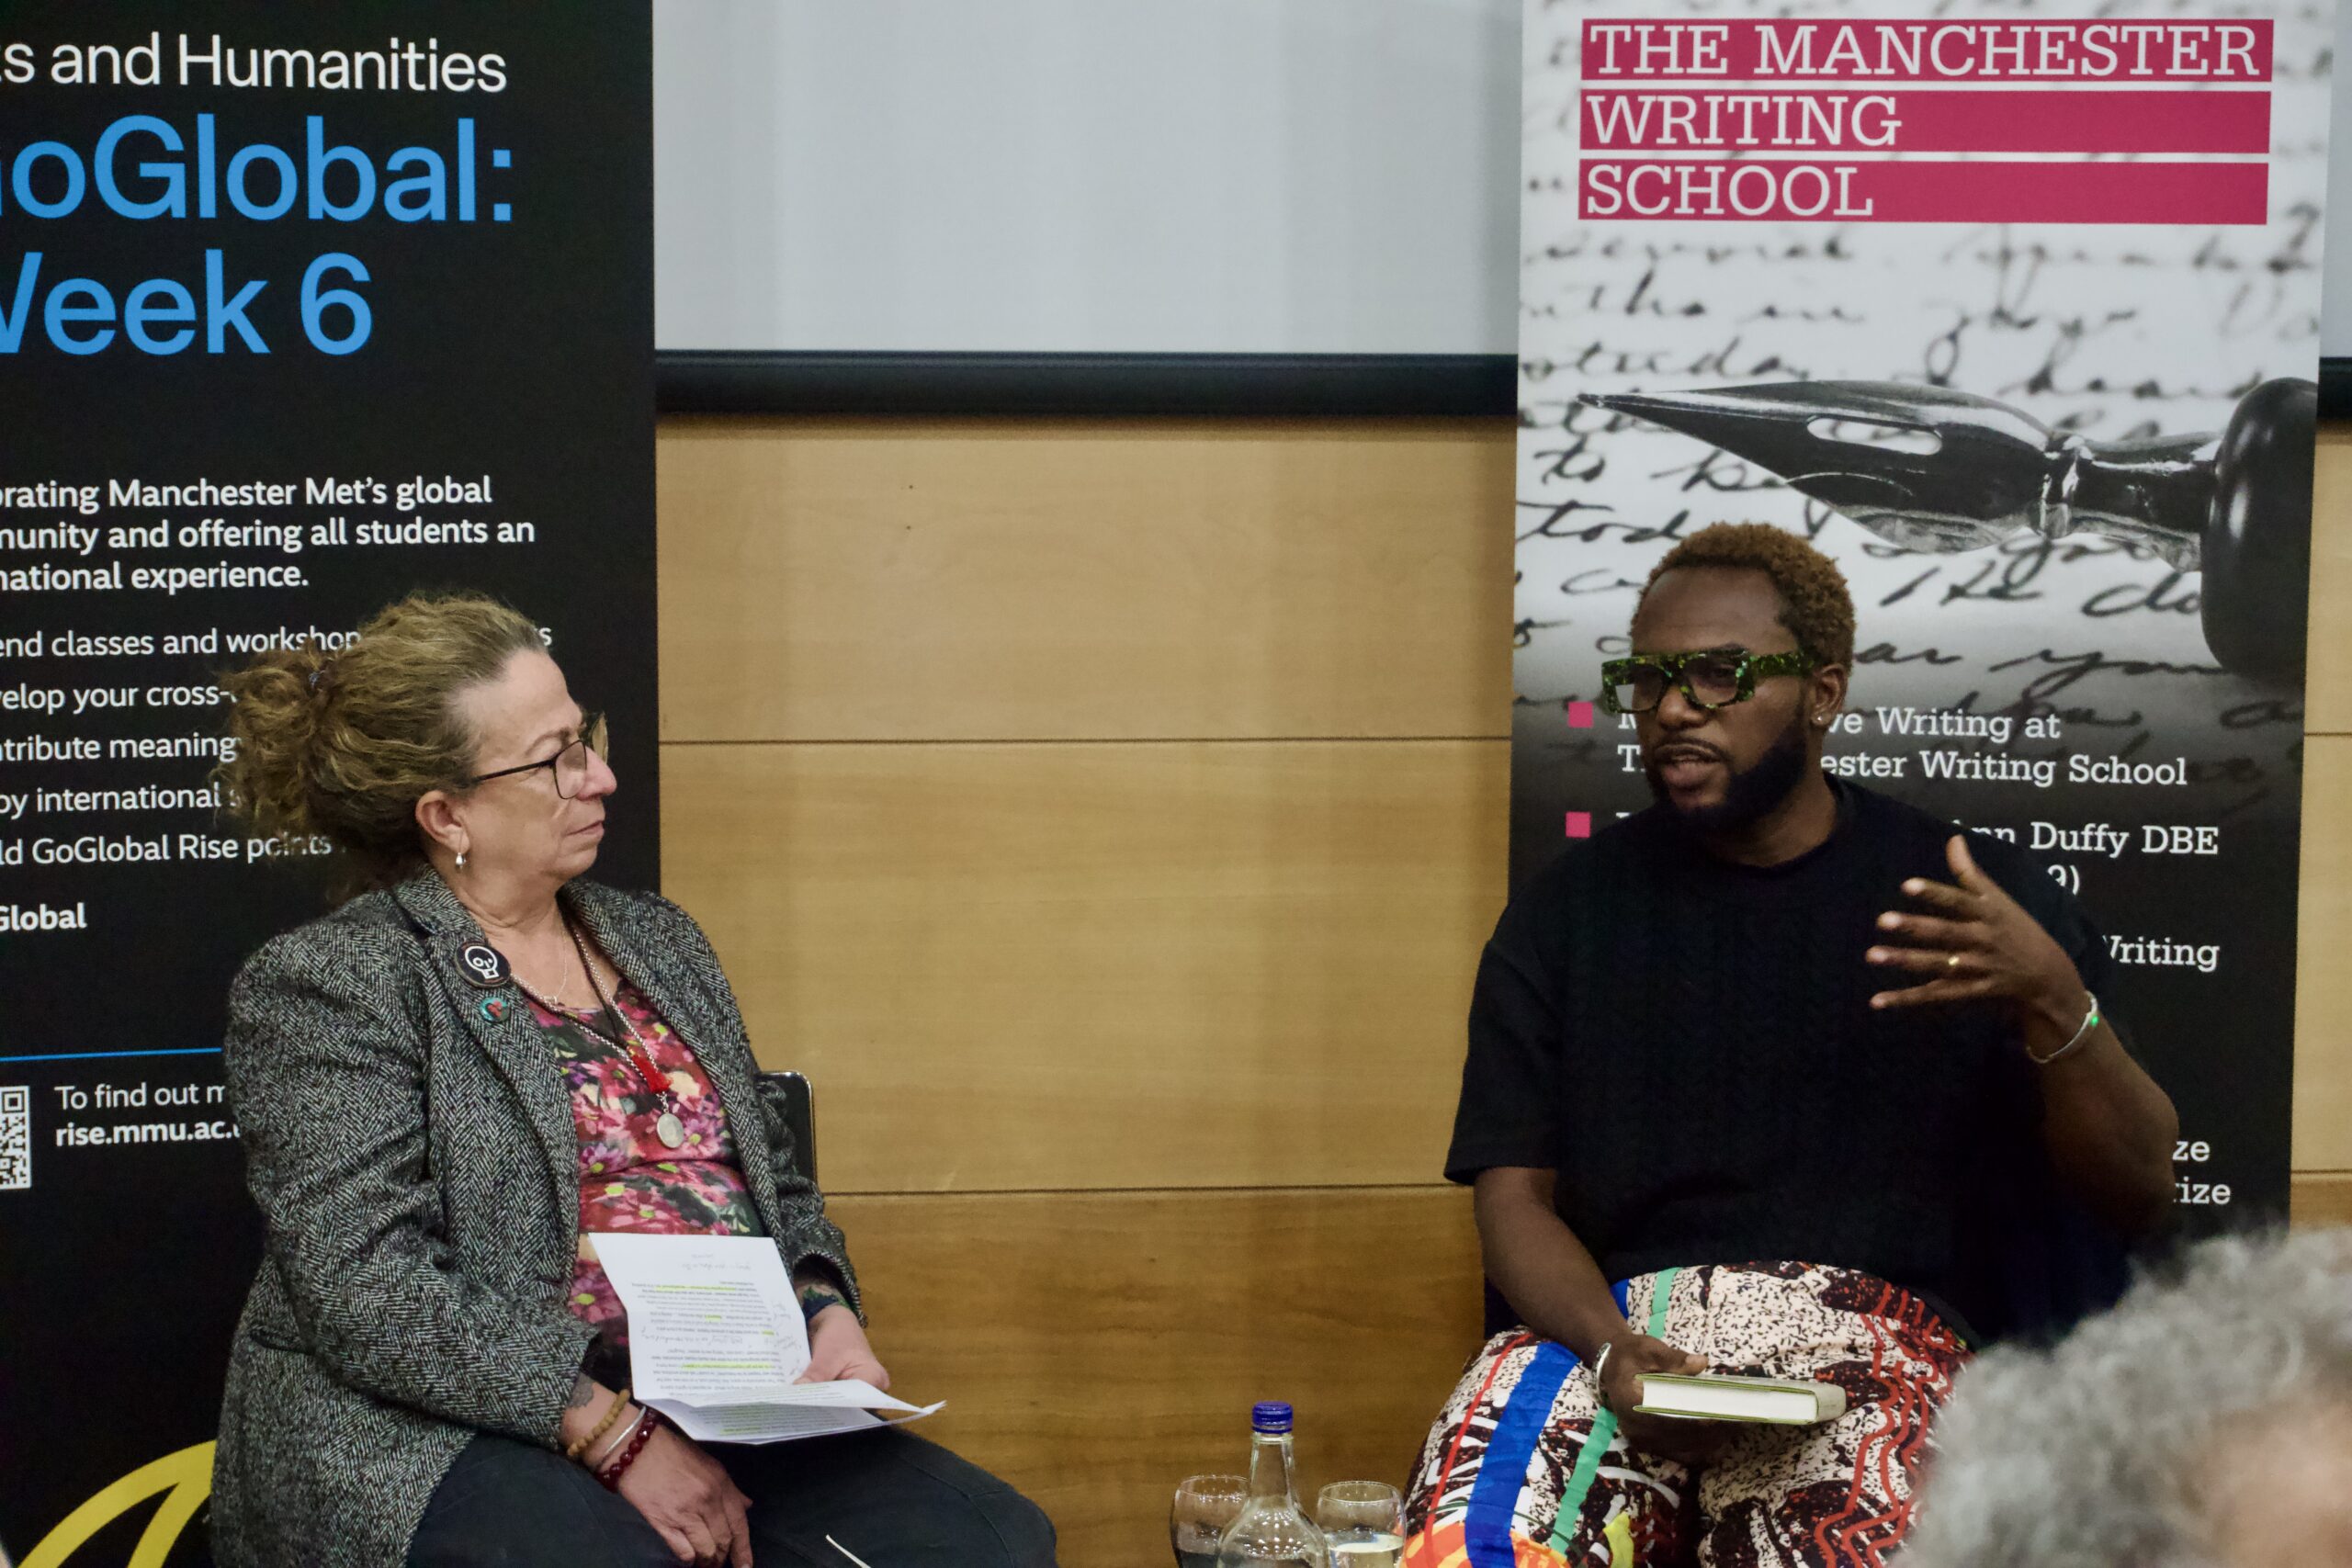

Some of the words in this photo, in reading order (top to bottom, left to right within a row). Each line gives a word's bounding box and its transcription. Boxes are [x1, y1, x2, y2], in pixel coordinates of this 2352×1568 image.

[51, 31, 161, 85] and
[179, 33, 507, 93] Humanities
[1589, 25, 1728, 74] THE
[1753, 25, 2261, 76] MANCHESTER
[1585, 95, 1903, 147] WRITING
[0, 113, 512, 223] oGlobal:
[1586, 164, 1874, 217] SCHOOL
[300, 252, 372, 355] 6
[0, 479, 100, 515] rating
[108, 478, 298, 507] Manchester
[396, 474, 493, 512] global
[107, 519, 169, 548] and
[178, 518, 303, 554] offering
[311, 516, 348, 546] all
[356, 515, 489, 545] students
[496, 522, 535, 543] an
[130, 560, 309, 596] experience.
[51, 629, 154, 657] classes
[163, 627, 218, 655] and
[0, 682, 65, 716] elop
[73, 687, 139, 715] your
[1875, 705, 2014, 744] Writing
[2024, 713, 2061, 739] at
[0, 734, 101, 761] tribute
[1918, 750, 2056, 787] Writing
[2069, 753, 2188, 785] School
[35, 781, 222, 812] international
[31, 834, 171, 864] GoGlobal
[178, 833, 239, 860] Rise
[2030, 821, 2130, 859] Duffy
[2141, 825, 2219, 855] DBE
[53, 1085, 88, 1111] To
[94, 1081, 147, 1109] find
[153, 1080, 200, 1108] out
